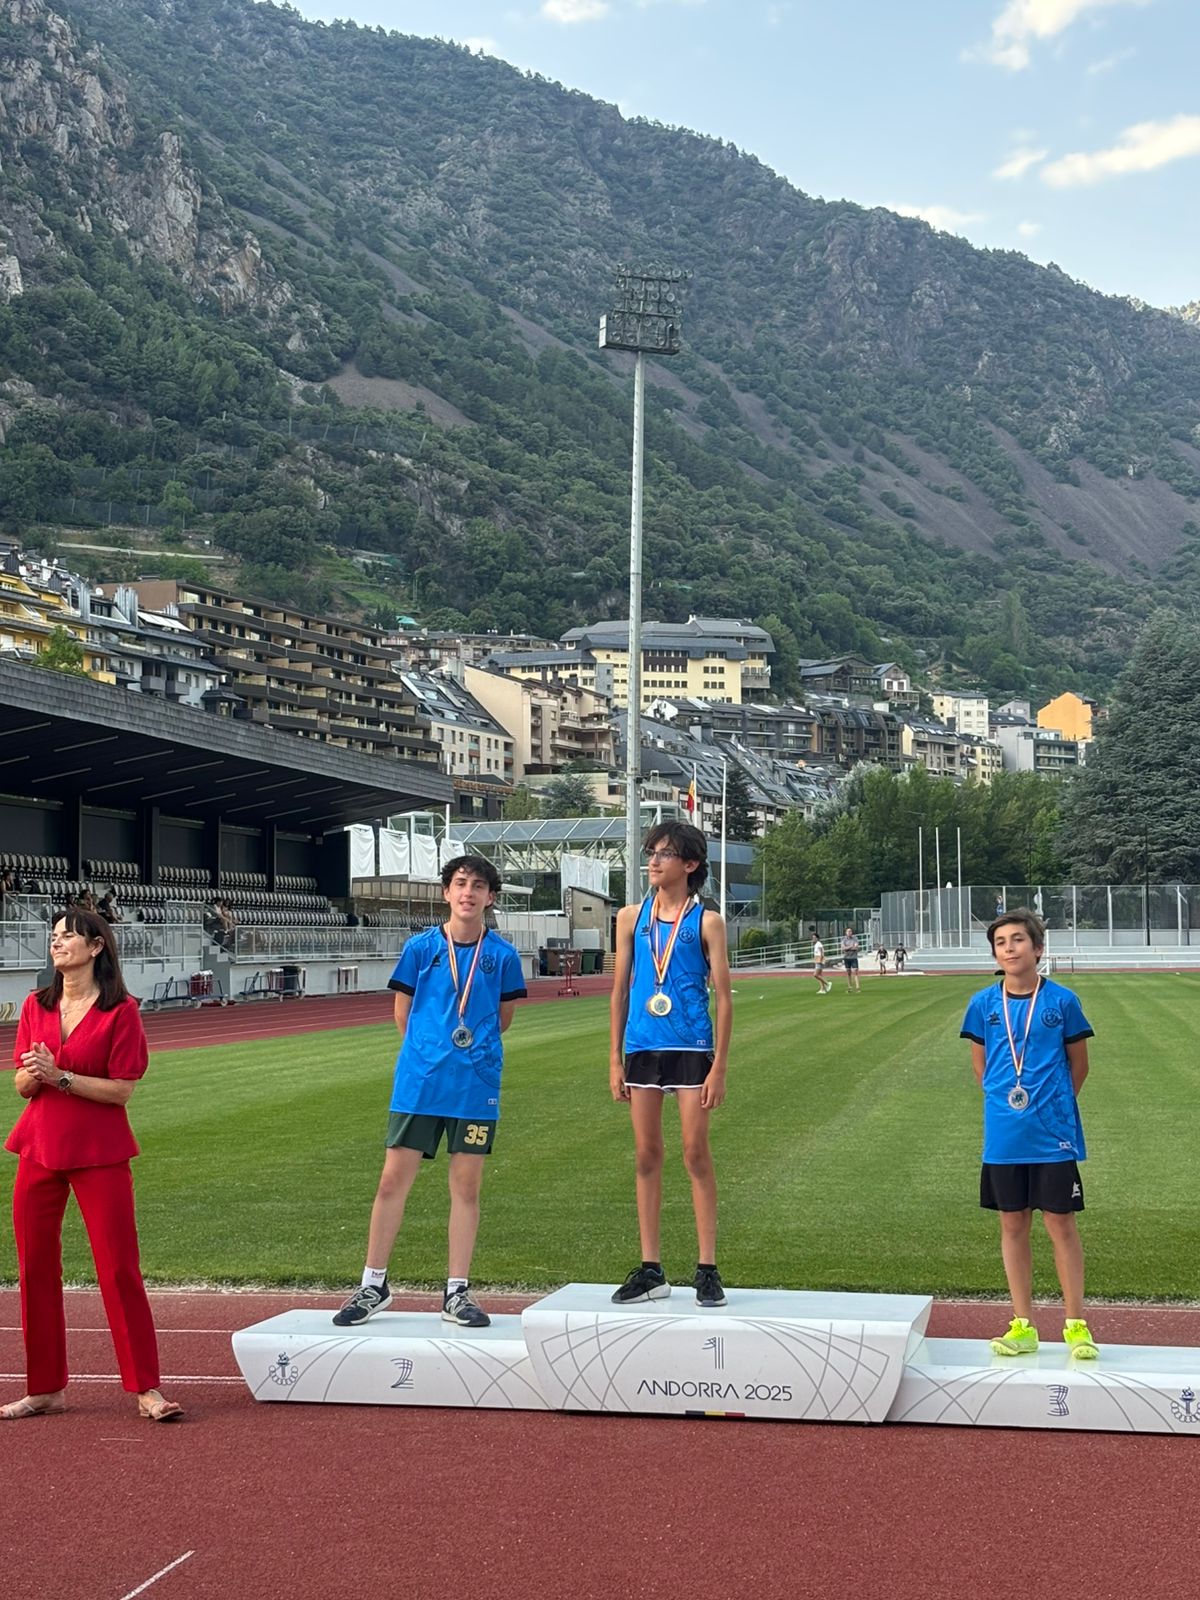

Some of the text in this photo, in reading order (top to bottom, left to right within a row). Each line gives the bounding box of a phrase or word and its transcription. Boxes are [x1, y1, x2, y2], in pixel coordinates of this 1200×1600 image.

[464, 1124, 489, 1146] 35
[701, 1336, 724, 1370] 1
[390, 1357, 414, 1389] 2
[637, 1379, 793, 1402] ANDORRA 2025
[1045, 1384, 1070, 1417] 3
